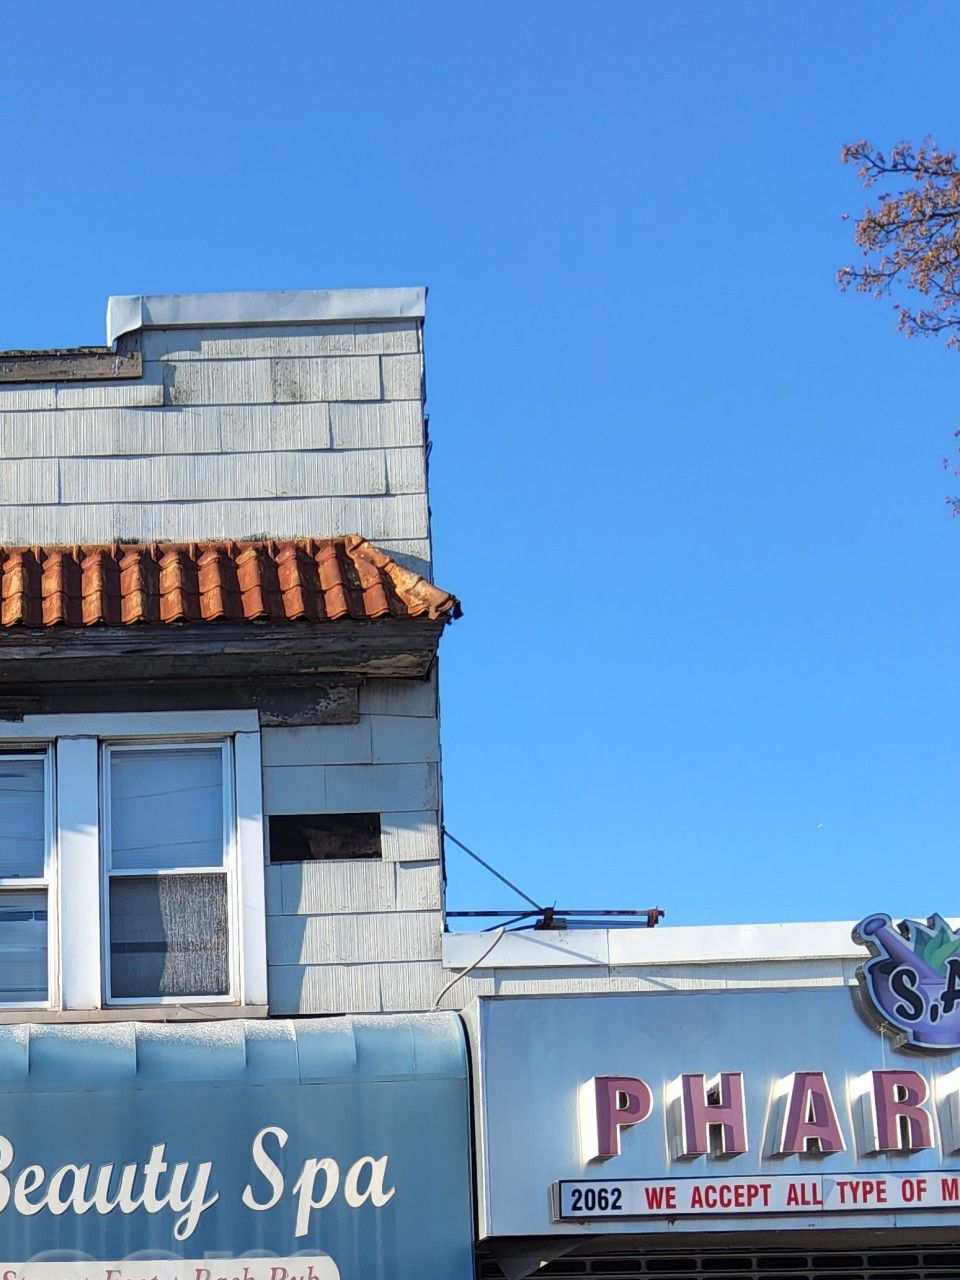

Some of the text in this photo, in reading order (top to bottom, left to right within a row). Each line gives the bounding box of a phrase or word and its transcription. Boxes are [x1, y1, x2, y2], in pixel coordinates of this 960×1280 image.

[590, 1069, 960, 1158] PHAR
[242, 1126, 396, 1238] Spa
[570, 1187, 623, 1213] 2062
[644, 1186, 677, 1211] WE
[690, 1183, 772, 1209] ACCEPT
[786, 1182, 823, 1206] ALL
[836, 1180, 887, 1204] TYPE
[901, 1178, 927, 1203] OF
